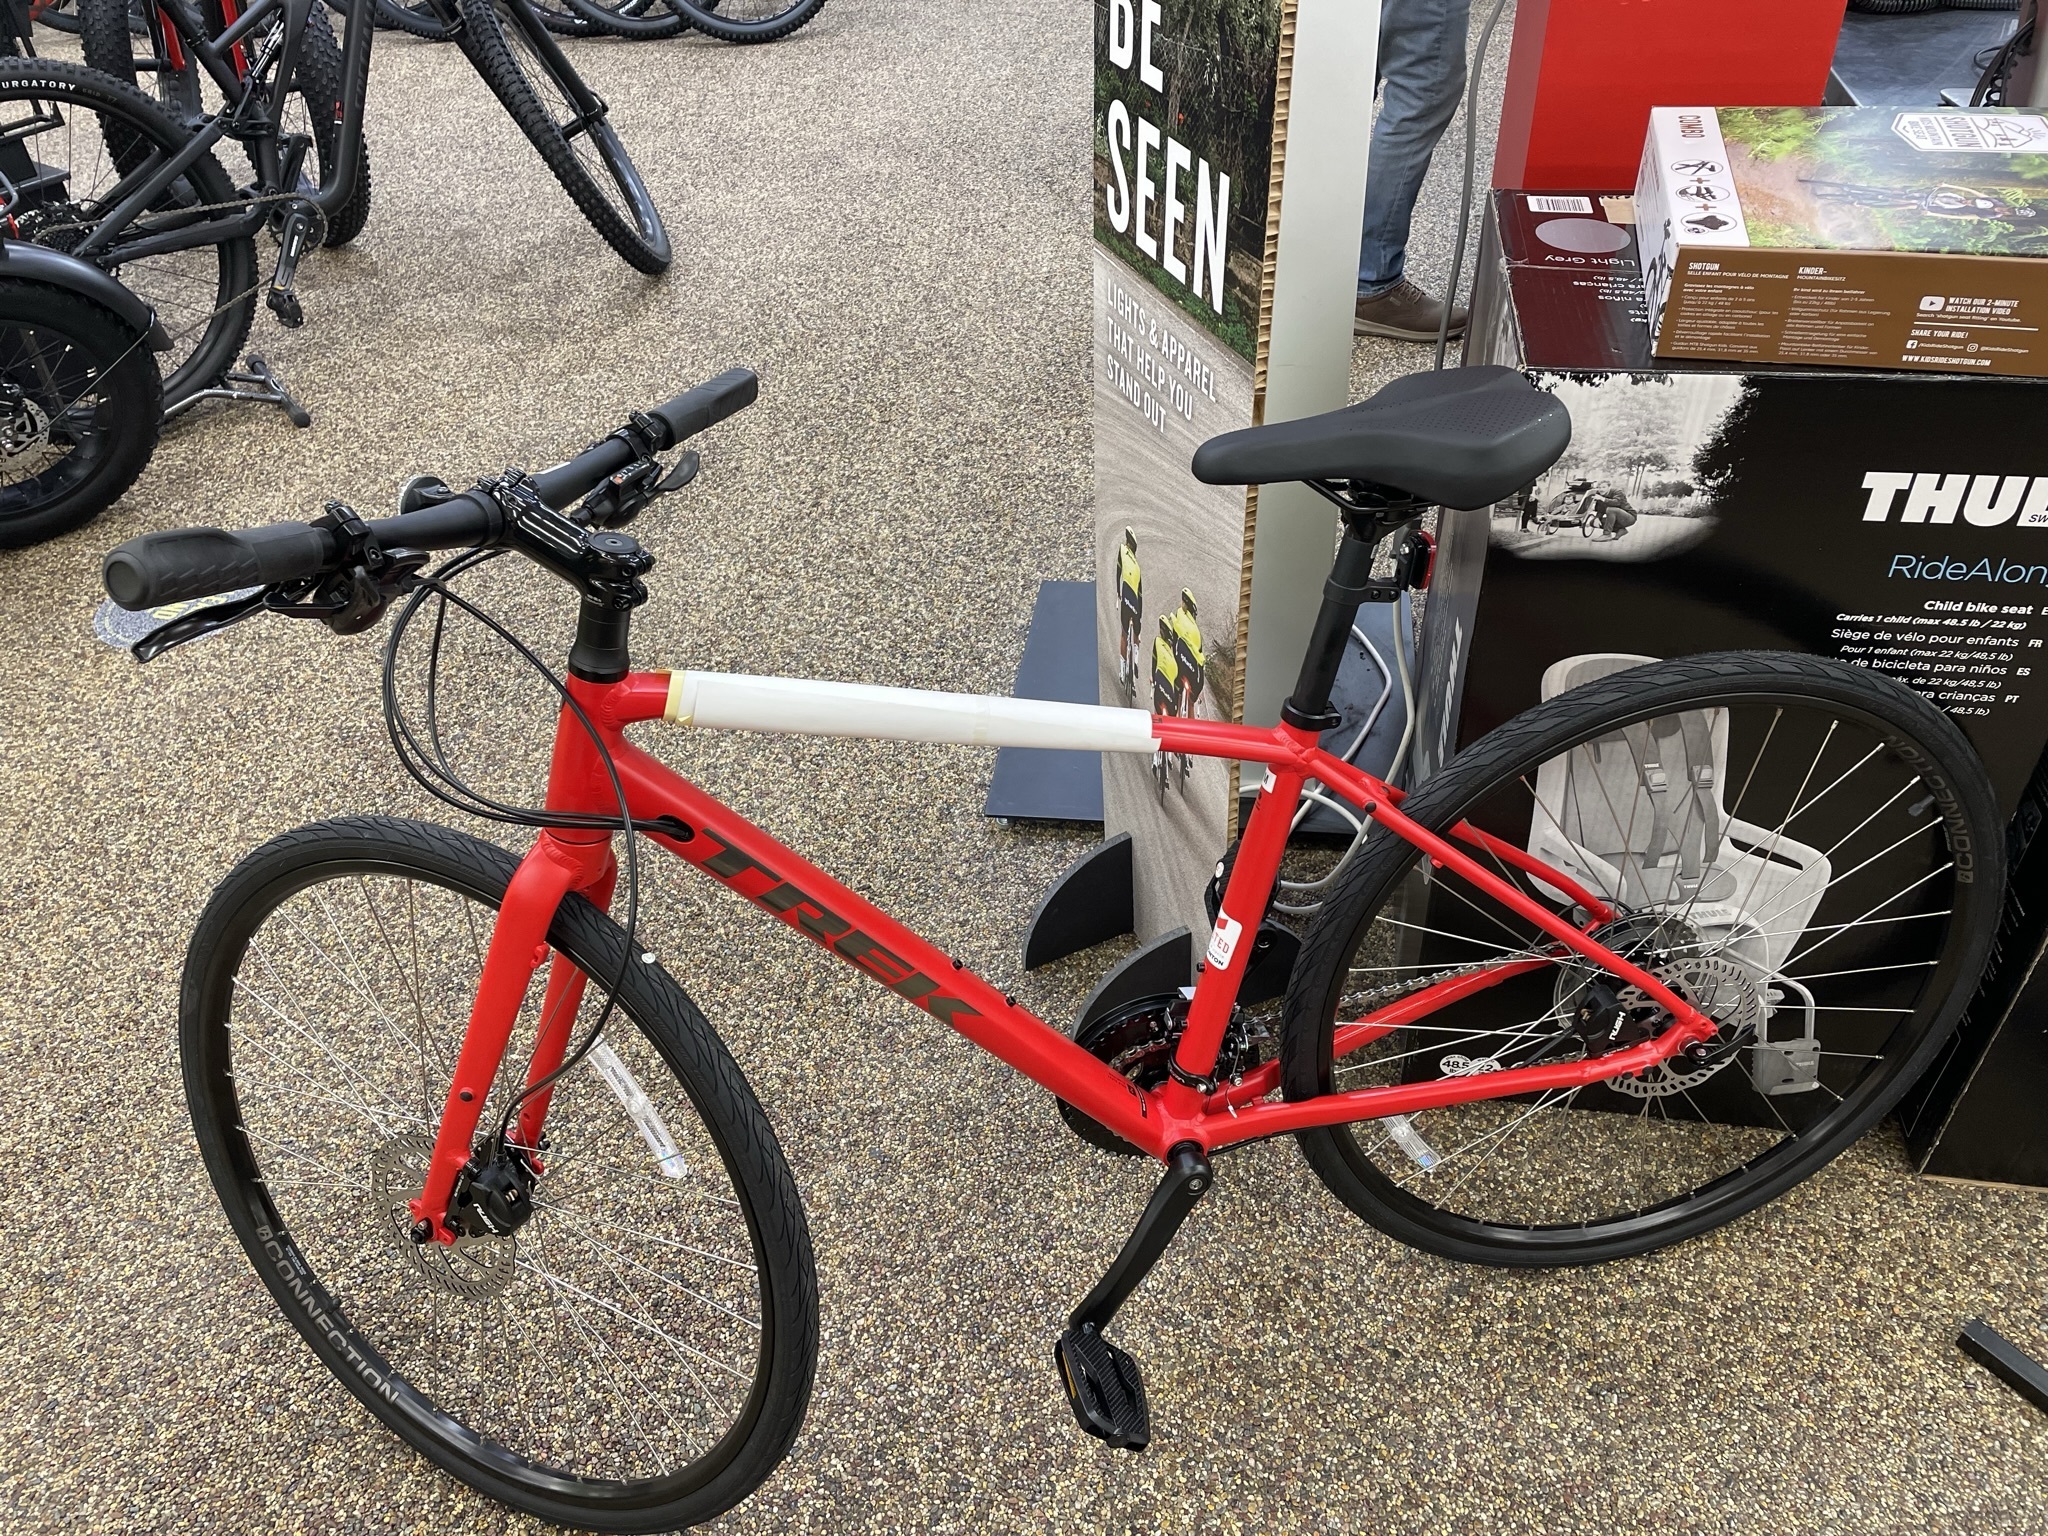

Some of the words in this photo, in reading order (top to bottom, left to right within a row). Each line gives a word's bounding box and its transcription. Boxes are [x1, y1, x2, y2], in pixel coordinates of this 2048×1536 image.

[1, 79, 76, 91] URGATORY
[1677, 114, 1705, 139] COMBO
[1941, 116, 1981, 148] SHOTGUN
[1106, 98, 1231, 316] SEEN
[1544, 254, 1586, 264] Grey
[1590, 257, 1636, 267] Light
[1688, 262, 1720, 271] SHOTGUN
[1798, 267, 1827, 275] KINDER-
[1948, 296, 1973, 304] WATCH
[1973, 298, 1986, 306] OUR
[1986, 299, 2020, 308] 2-MINUTE
[1945, 305, 1991, 314] INSTALLATION
[1991, 307, 2012, 315] VIDEO
[1107, 277, 1146, 336] LIGHTS
[1149, 318, 1159, 349] &
[1161, 329, 1217, 403] APPAREL
[1933, 330, 1951, 338] YOUR
[1950, 331, 1969, 339] RIDE!
[1901, 354, 1992, 366] WWW.KIDSRIDESHOTGUN.COM
[1107, 315, 1134, 363] THAT
[1136, 344, 1166, 392] HELP
[1168, 374, 1193, 421] YOU
[1107, 353, 1141, 408] STAND
[1143, 391, 1167, 433] OUT
[2028, 514, 2048, 523] SW
[1888, 554, 2048, 588] RideAlon
[1923, 600, 1964, 612] Child
[1965, 602, 1998, 613] bike
[2001, 605, 2034, 615] seat
[2041, 606, 2048, 616] E
[1836, 613, 1875, 623] Carries
[1875, 615, 1883, 623] 1
[1883, 615, 1912, 624] child
[1912, 617, 1942, 625] (max
[1942, 618, 1969, 626] 48.5
[1968, 619, 1981, 627] lb
[2006, 621, 2027, 631] kg)
[1831, 628, 1871, 641] Siège
[1873, 630, 1892, 640] de
[1896, 632, 1926, 642] vélo
[1928, 635, 1965, 645] pour
[1966, 635, 2020, 647] enfants
[2028, 639, 2043, 648] FR
[1840, 645, 1867, 653] Pour
[1867, 646, 1874, 654] 1
[1874, 647, 1909, 656] enfant
[1910, 648, 1938, 657] (max
[1938, 650, 1954, 658] 22
[1954, 651, 1998, 661] kg/48,5
[1997, 653, 2014, 662] lb)
[1851, 658, 1869, 668] de
[1872, 658, 1931, 671] bicicleta
[1933, 663, 1966, 673] para
[1969, 664, 2008, 675] niños
[2016, 667, 2031, 676] ES
[1912, 677, 1927, 685] de
[1943, 679, 1986, 688] kg/48,5
[1985, 680, 2002, 690] lb)
[1938, 691, 1996, 703] crianças
[2004, 695, 2020, 704] PT
[1949, 706, 1975, 715] 48,5
[1974, 707, 1990, 717] lb)
[1688, 909, 1732, 919] THULE
[701, 827, 984, 1028] TREK
[264, 1239, 400, 1404] CONNECTION
